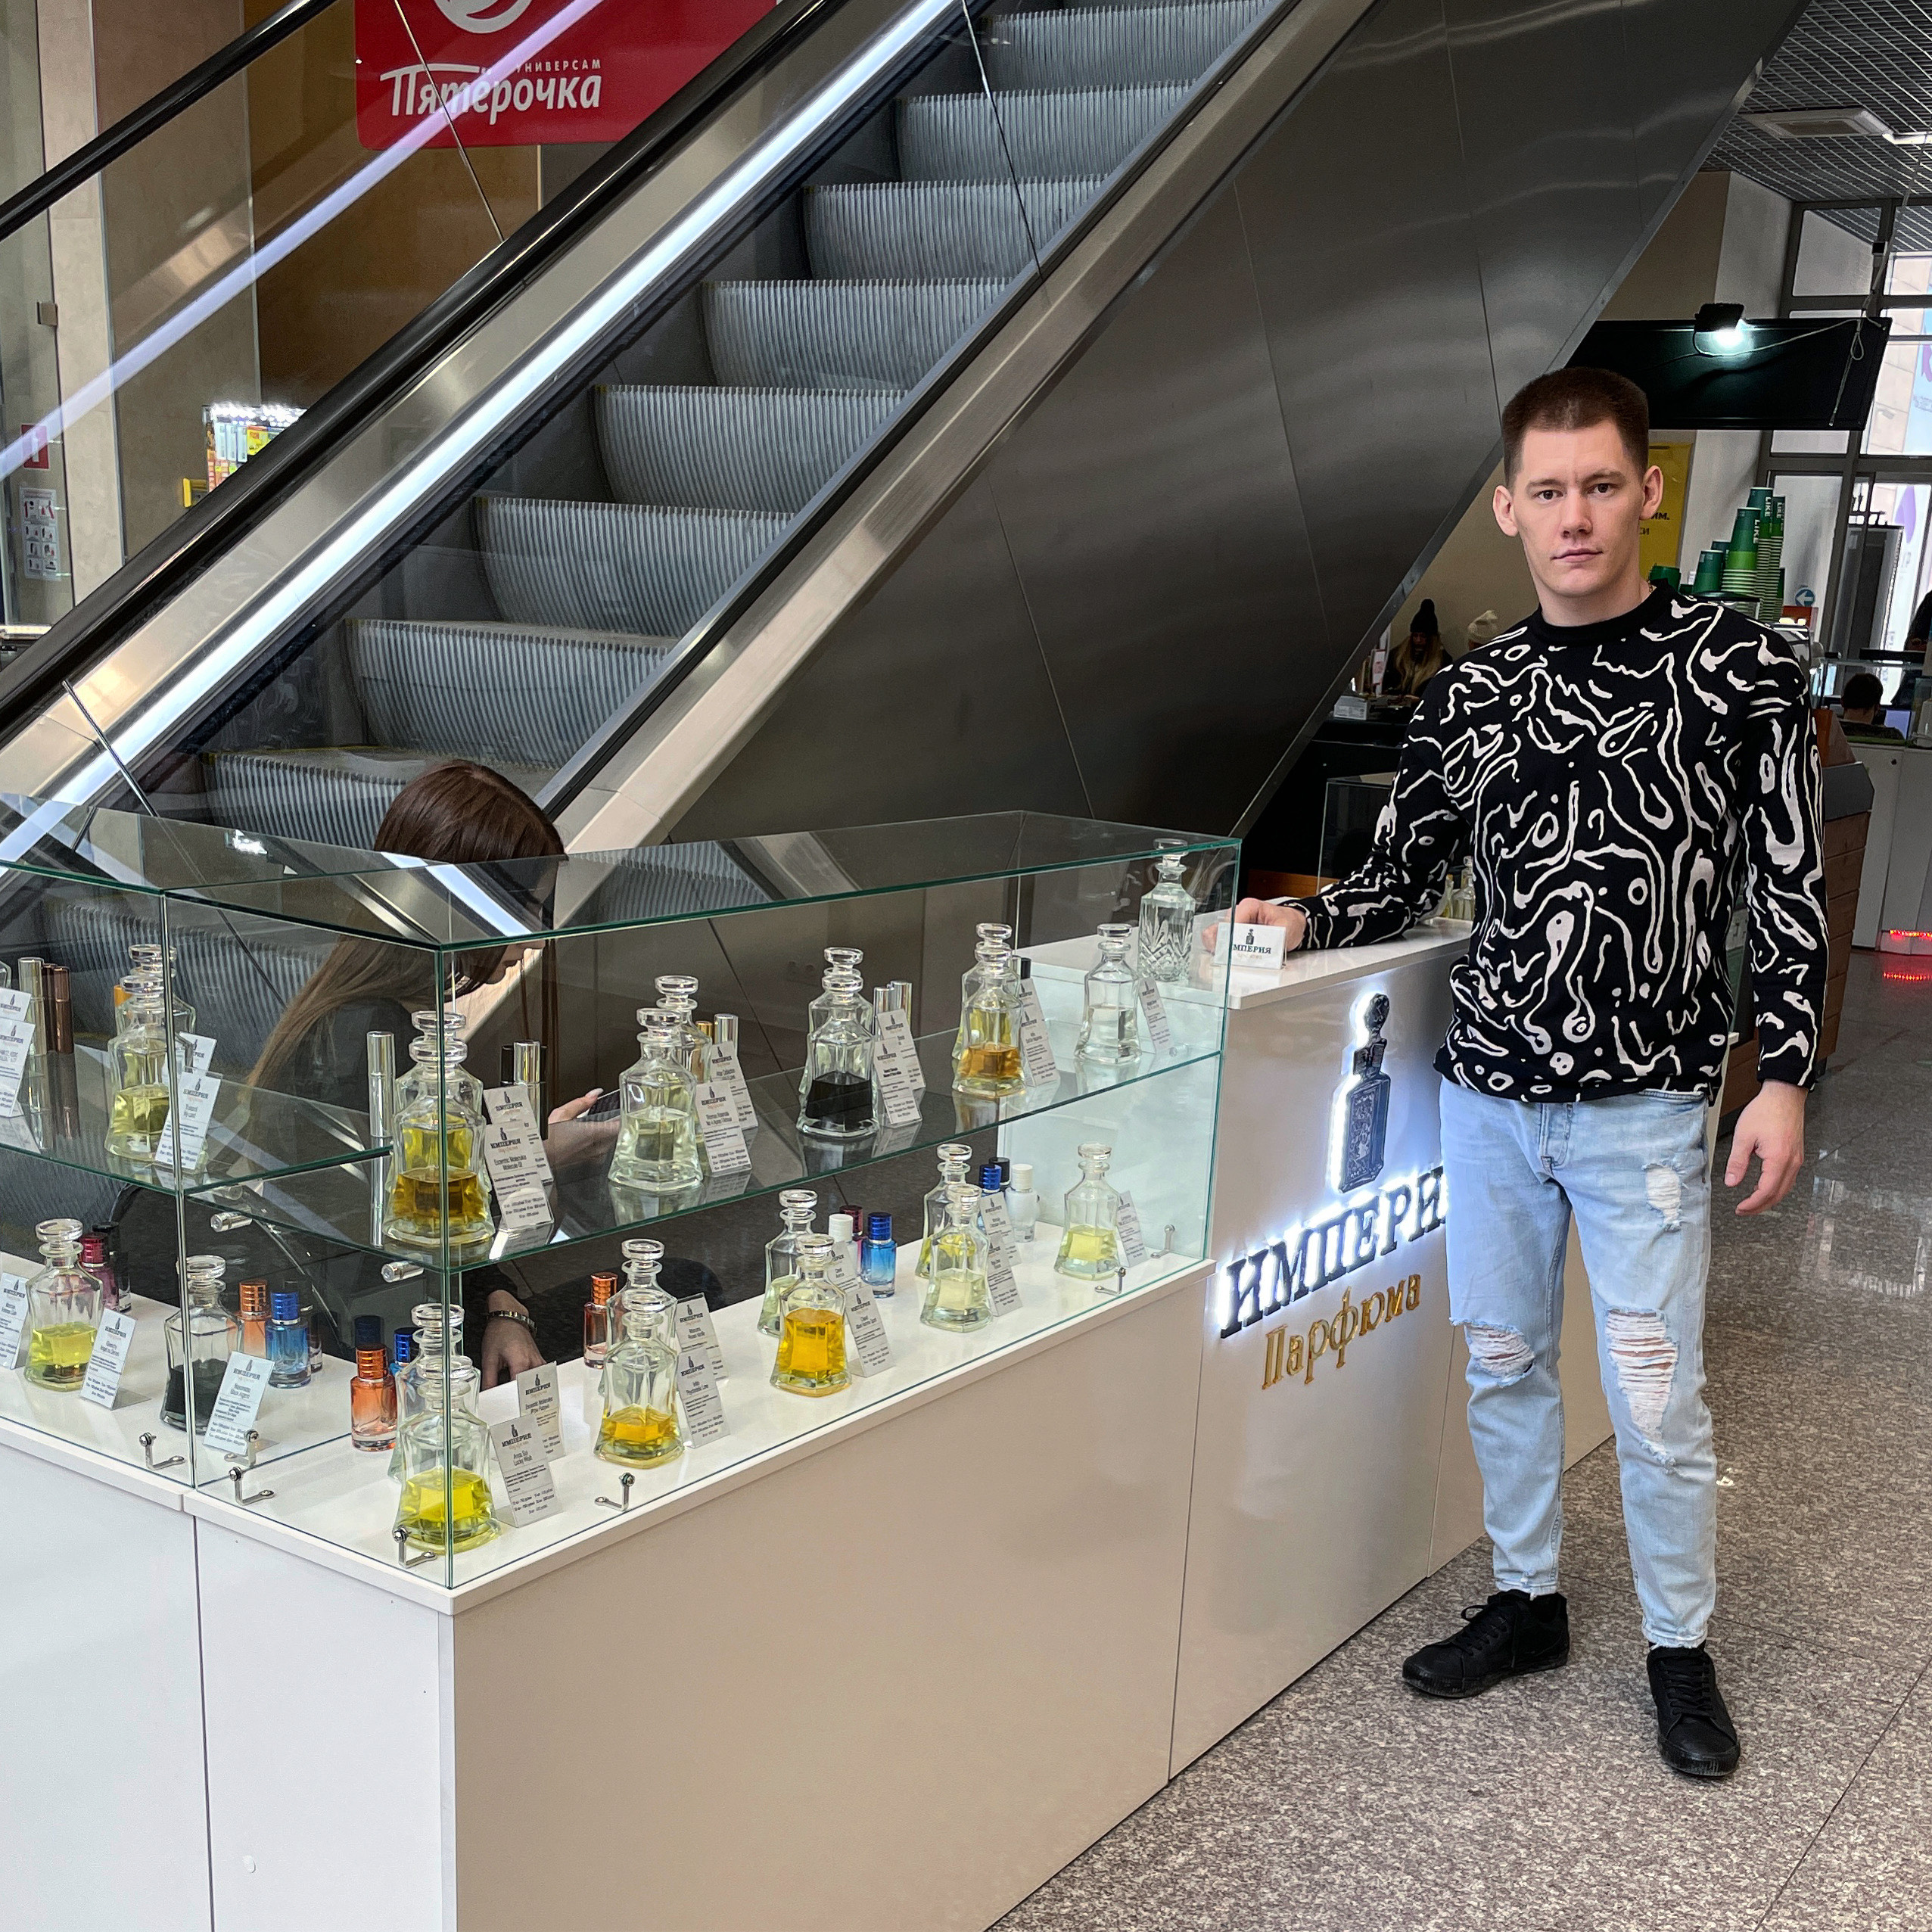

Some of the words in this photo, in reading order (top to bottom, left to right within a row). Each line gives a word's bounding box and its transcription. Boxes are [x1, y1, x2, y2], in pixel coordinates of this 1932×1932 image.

[1233, 944, 1271, 954] МПЕРИЯ
[1221, 1166, 1446, 1339] ИМПЕРИ
[1262, 1274, 1420, 1390] Парфюма
